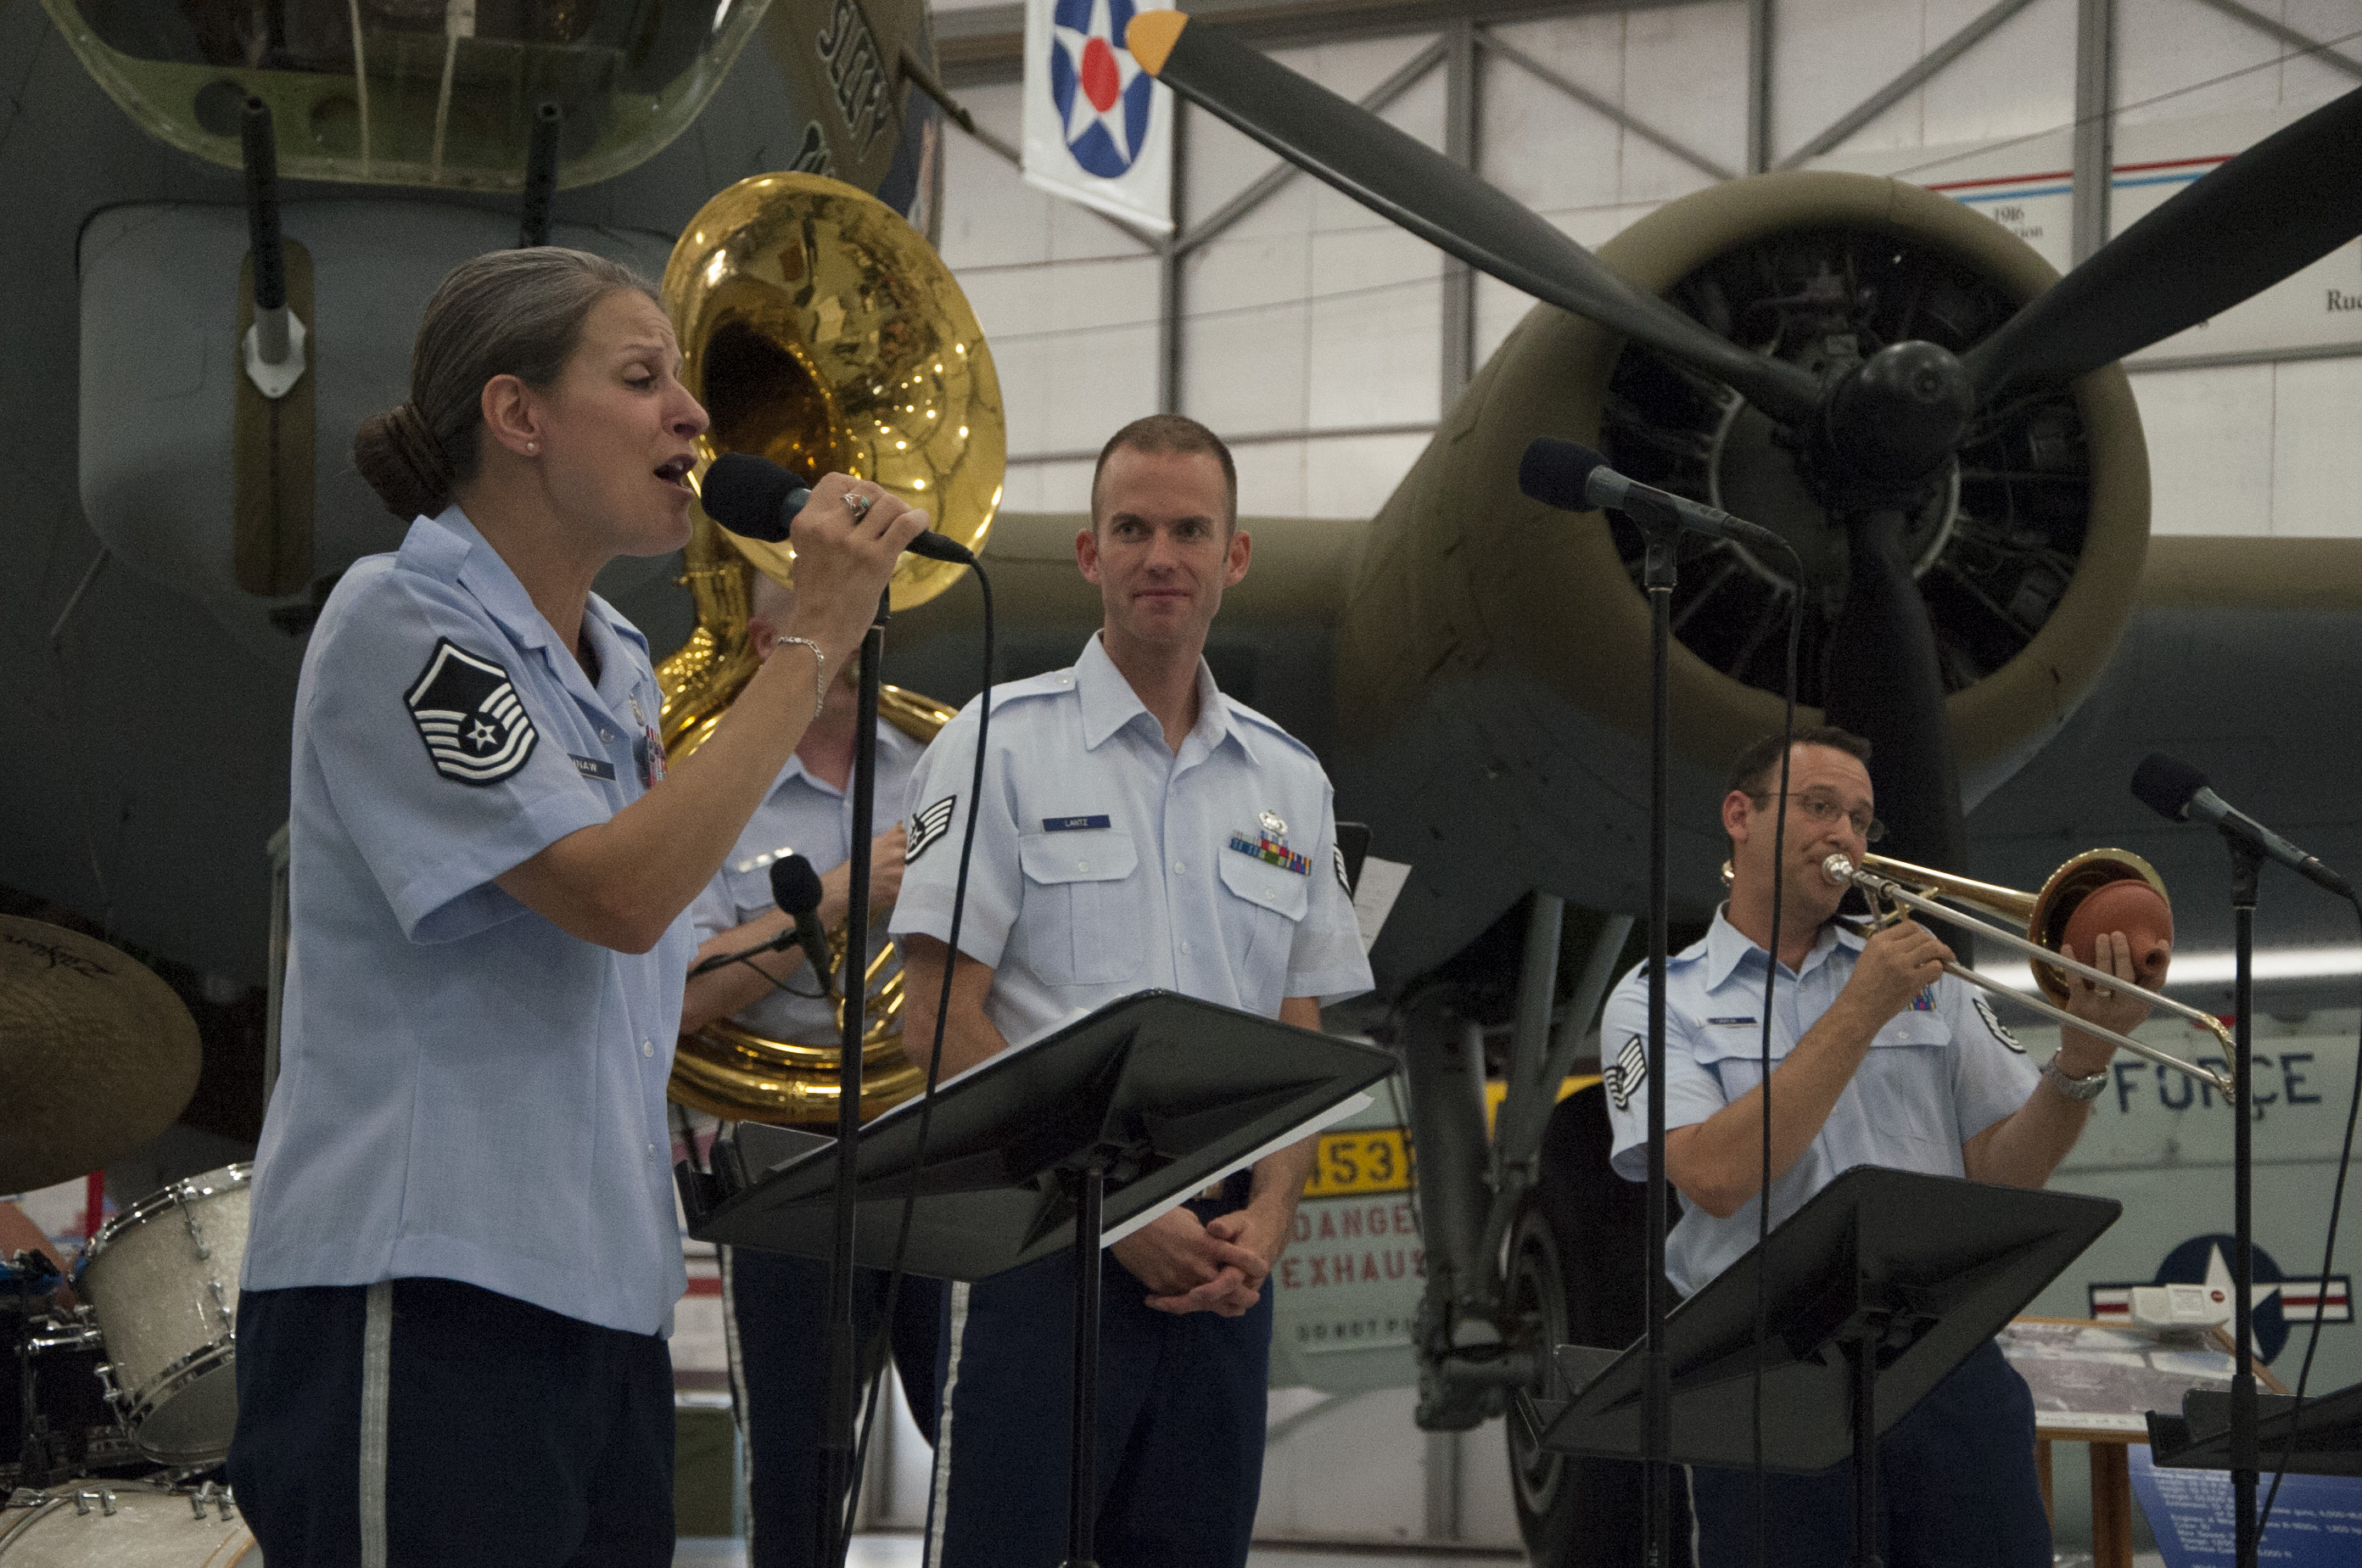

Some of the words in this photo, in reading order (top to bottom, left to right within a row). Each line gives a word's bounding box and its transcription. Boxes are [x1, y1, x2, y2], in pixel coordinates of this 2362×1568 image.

[1065, 818, 1089, 828] LANTZ
[2113, 1052, 2323, 1113] FORCE
[1292, 1204, 1415, 1244] DANGE
[1281, 1249, 1425, 1290] EXHAUS
